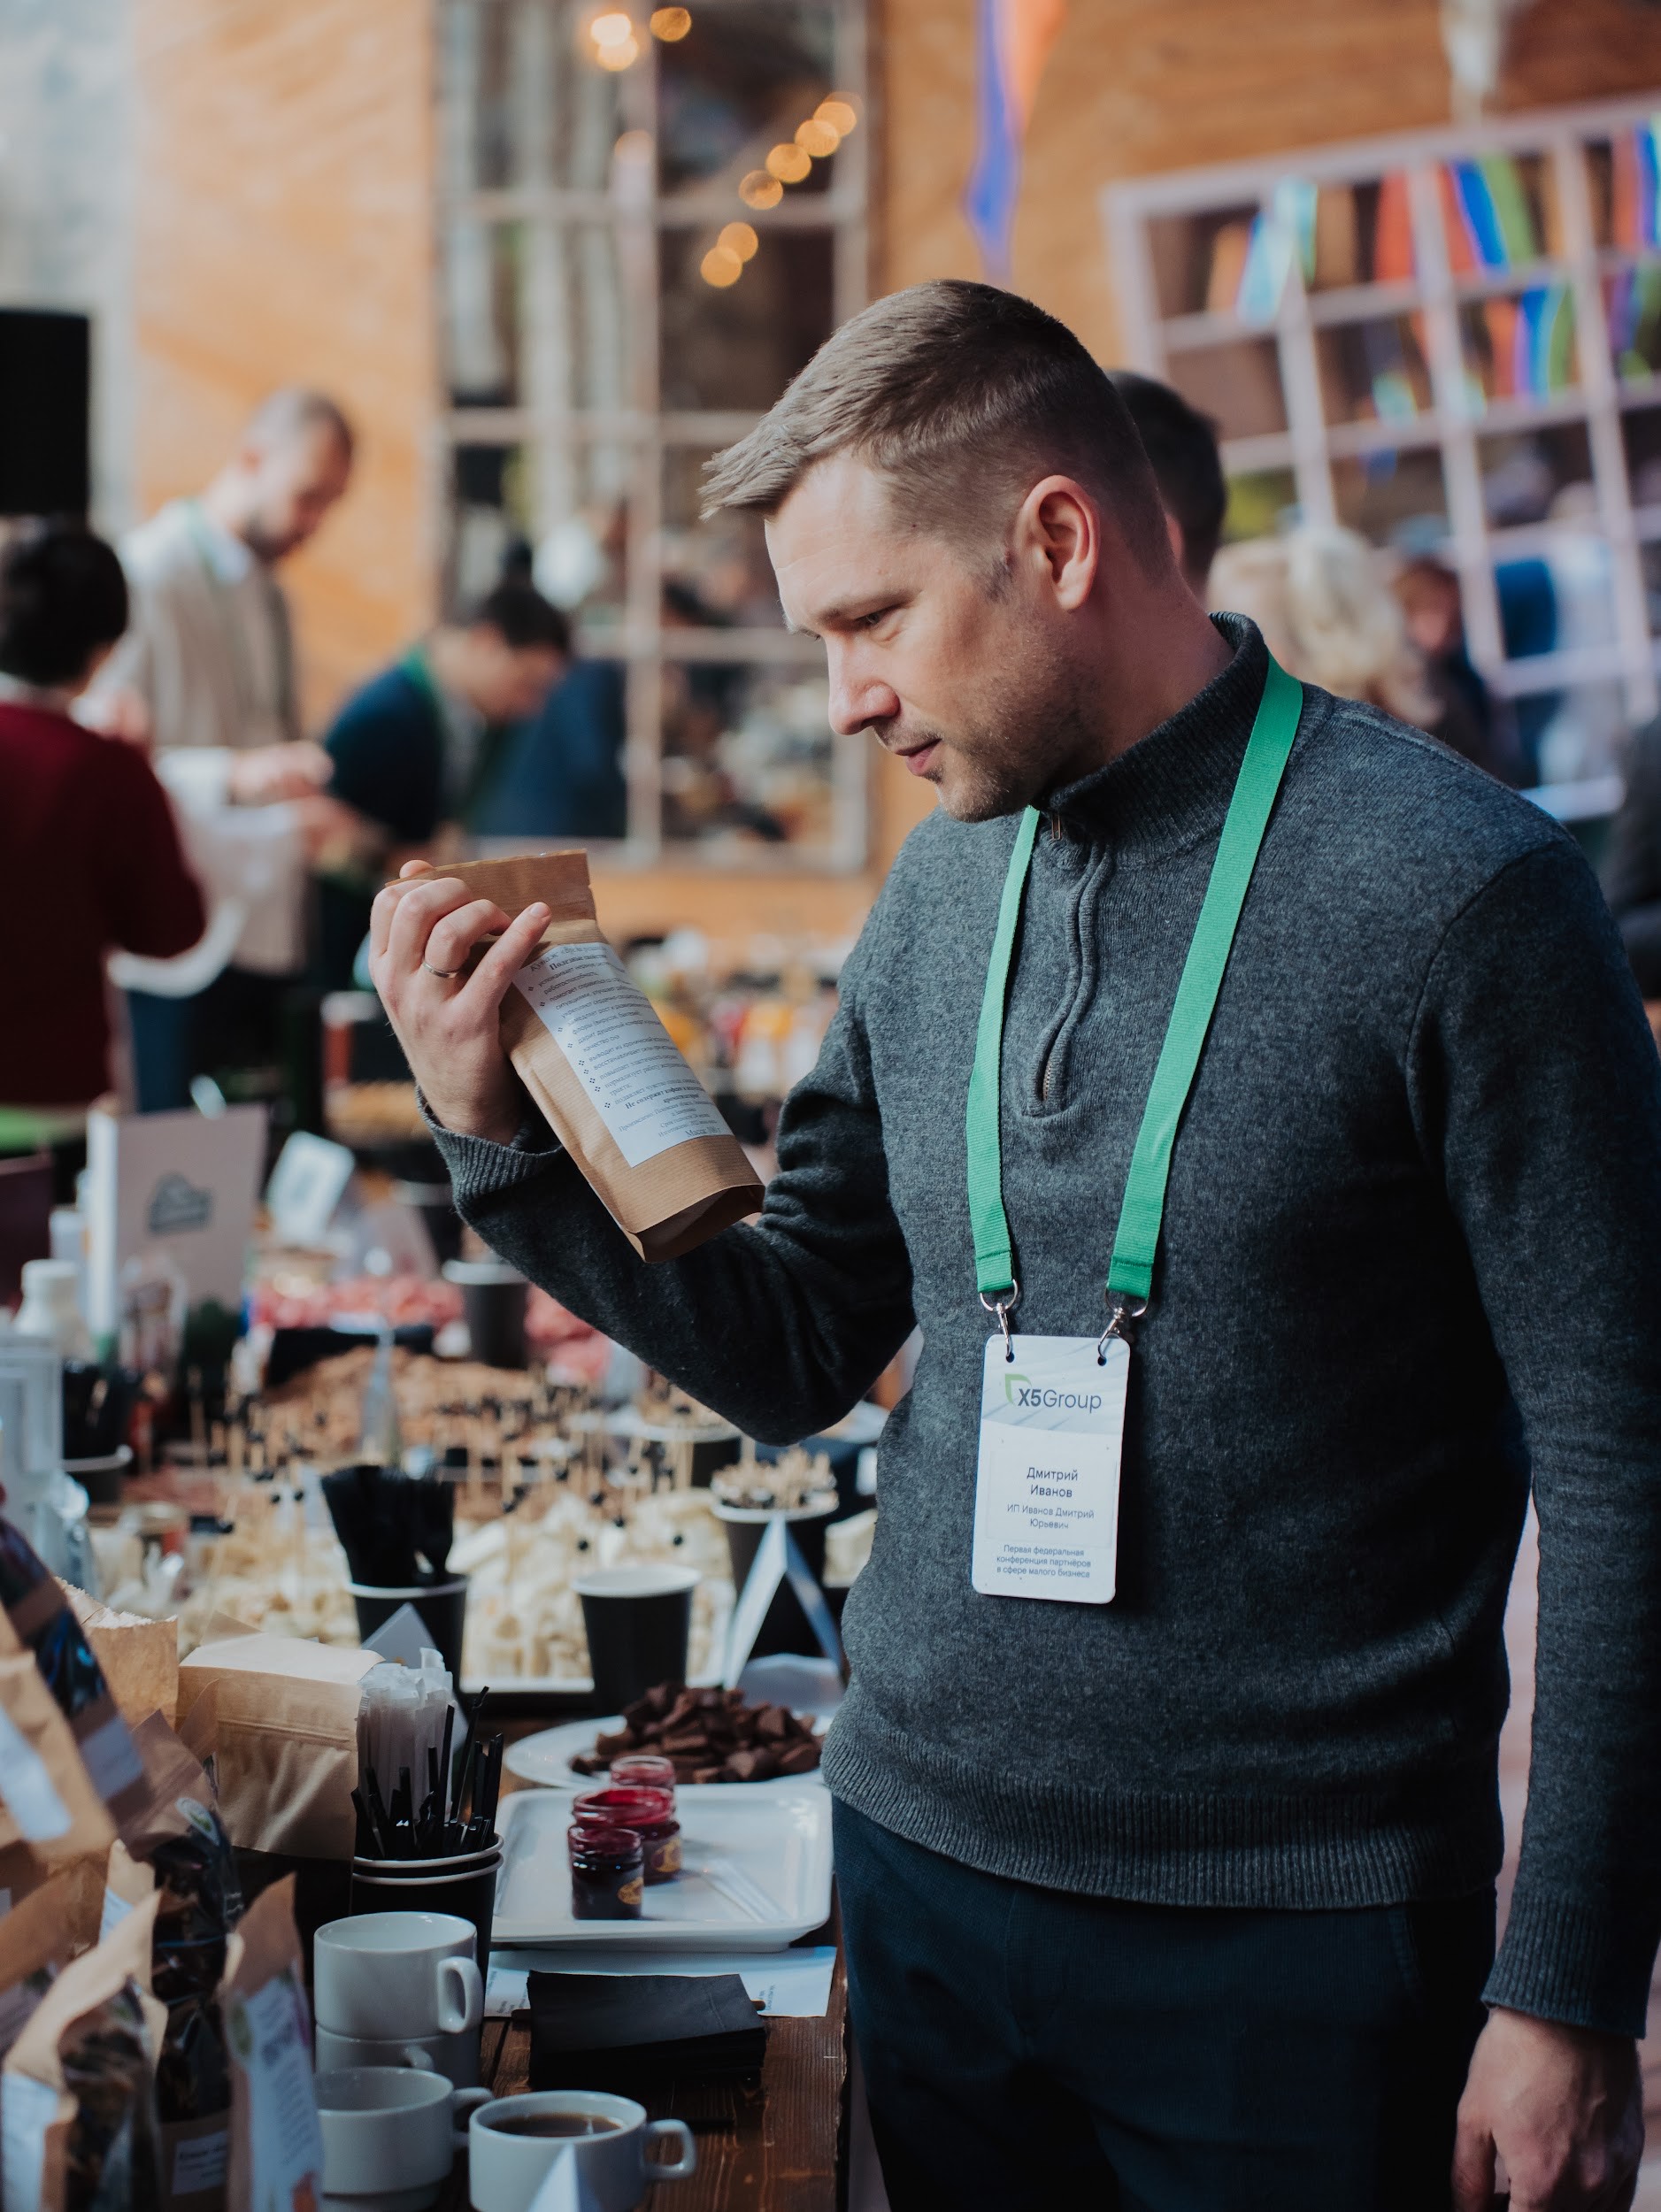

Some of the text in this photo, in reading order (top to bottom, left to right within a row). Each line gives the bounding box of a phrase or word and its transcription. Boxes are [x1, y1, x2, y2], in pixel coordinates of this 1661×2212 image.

[1018, 1388, 1102, 1414] X5Group
[1027, 1467, 1079, 1482] Дмитрий
[1030, 1485, 1073, 1498] Иванов
[1007, 1504, 1095, 1519] ИП Иванов Дмитрий
[1030, 1518, 1069, 1529] Юрьевич
[1004, 1545, 1085, 1556] Первая федеральная
[996, 1555, 1049, 1564] конференция
[1003, 1565, 1027, 1575] сфере
[1057, 1568, 1091, 1578] бизнеса
